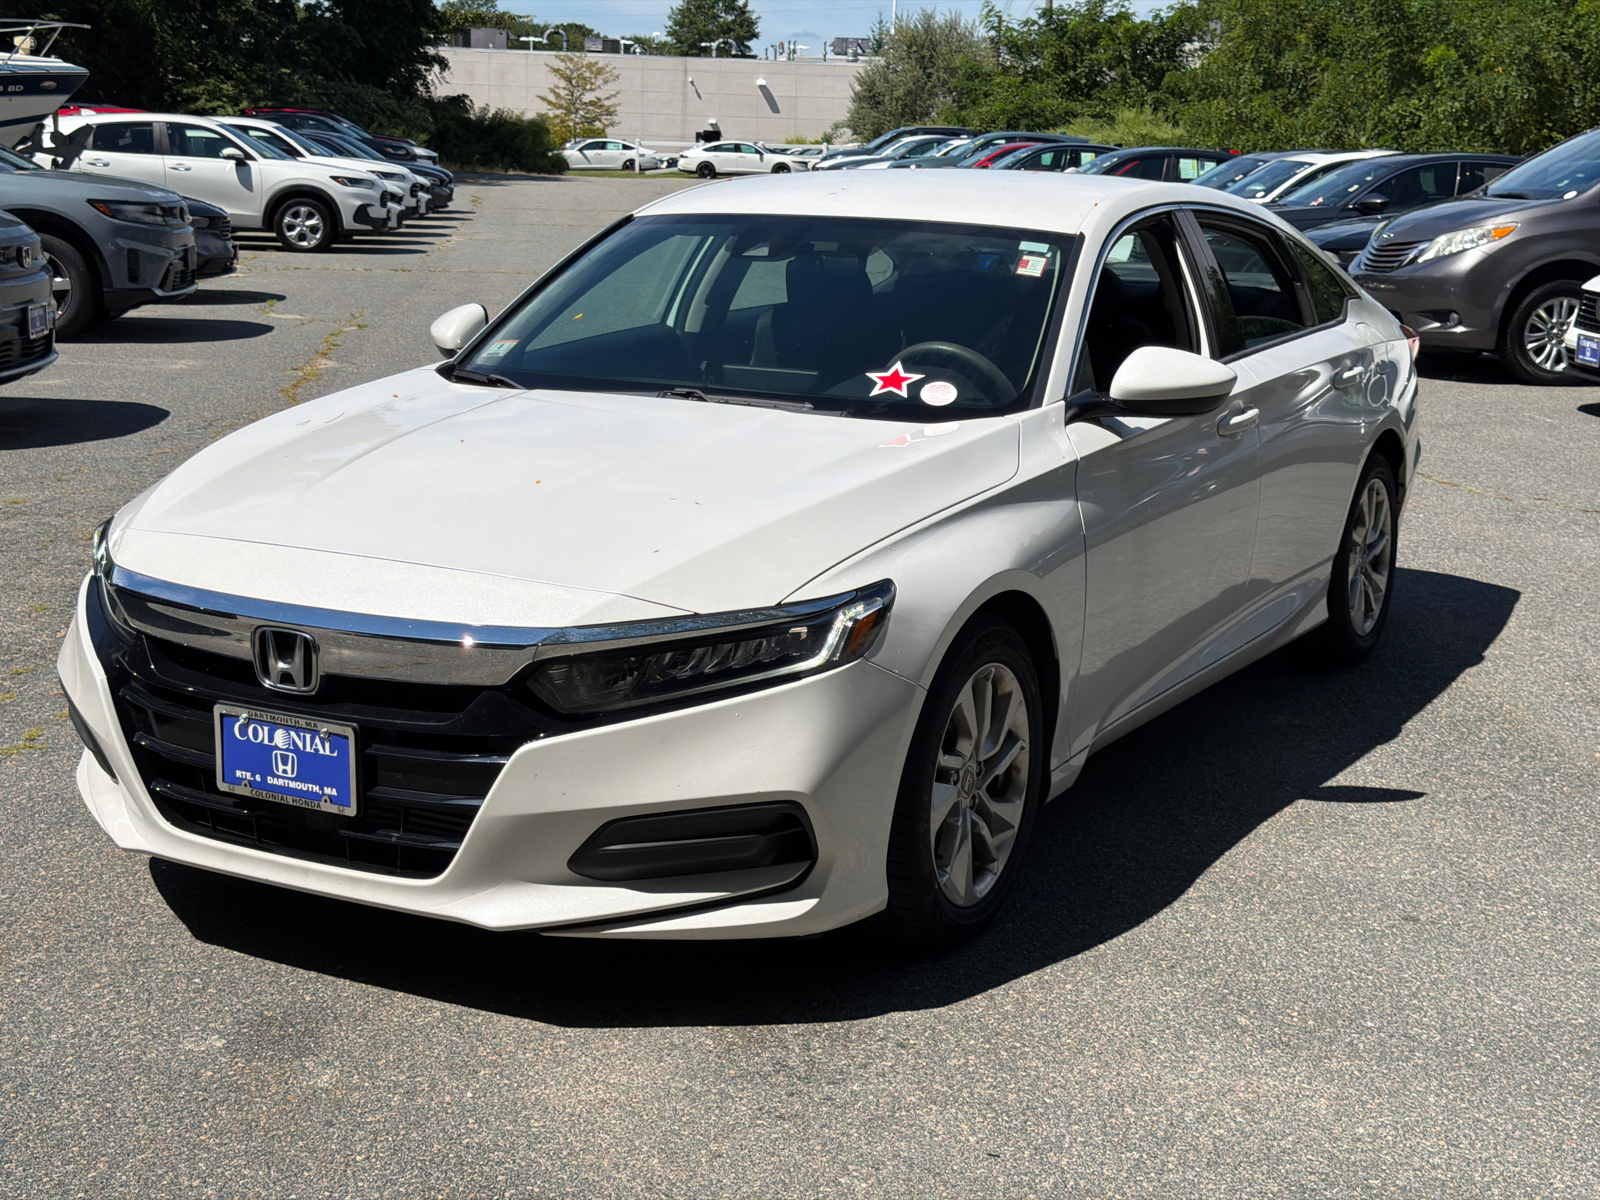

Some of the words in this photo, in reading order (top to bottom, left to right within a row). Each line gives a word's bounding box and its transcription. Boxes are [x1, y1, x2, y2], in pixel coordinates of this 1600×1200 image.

[247, 710, 303, 727] DARTMOUTH,
[305, 721, 319, 729] MA
[233, 721, 338, 757] COLONIAL
[235, 770, 254, 781] RTE.
[255, 774, 261, 782] 6
[267, 776, 323, 794] DARTMOUTH,
[323, 786, 338, 796] MA
[250, 789, 290, 804] COLONIAL
[291, 798, 322, 810] HONDA
